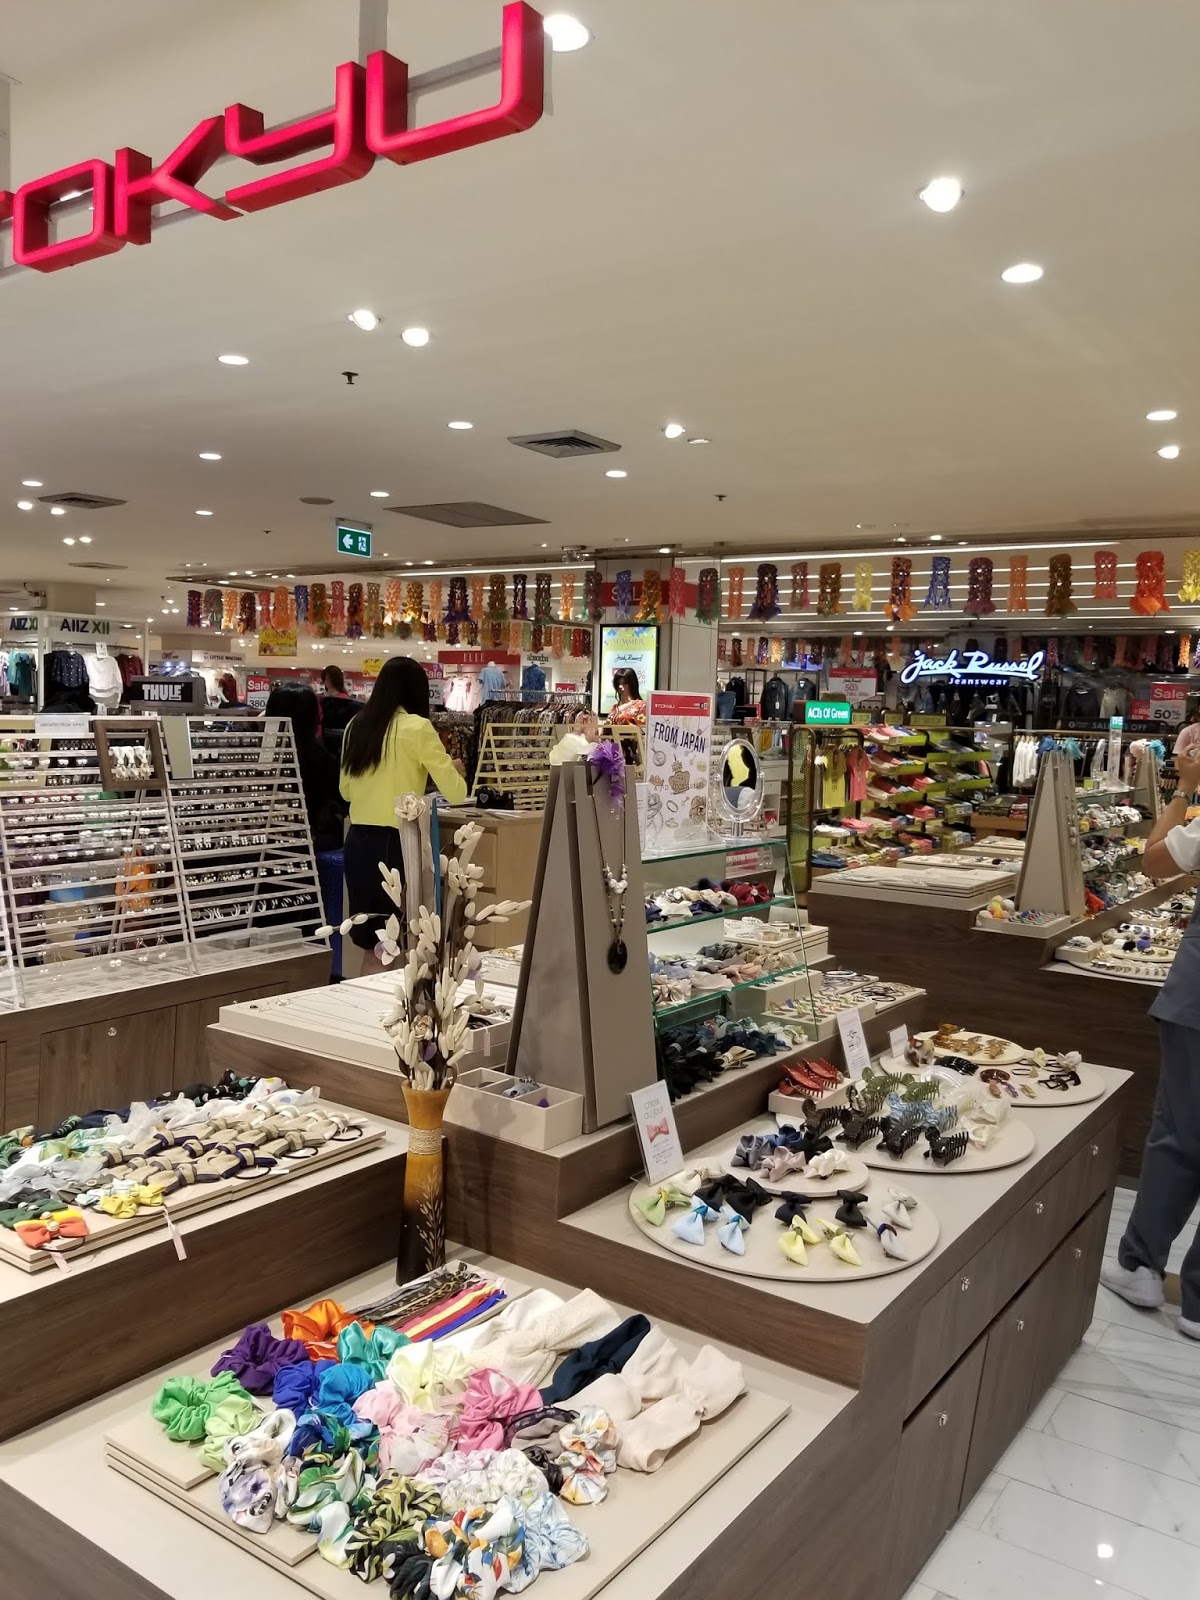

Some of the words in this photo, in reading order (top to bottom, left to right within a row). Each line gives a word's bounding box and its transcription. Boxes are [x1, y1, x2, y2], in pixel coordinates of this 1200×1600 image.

[0, 0, 544, 273] OKYU
[92, 621, 110, 634] XII
[463, 652, 485, 663] ELLE
[962, 650, 1044, 680] Russel
[247, 680, 270, 691] Sale
[948, 678, 1008, 686] Jeanswear
[142, 684, 182, 701] THULE
[1153, 688, 1185, 700] Sale
[831, 707, 848, 719] Green
[653, 721, 679, 745] FROM
[679, 730, 706, 754] JAPAN
